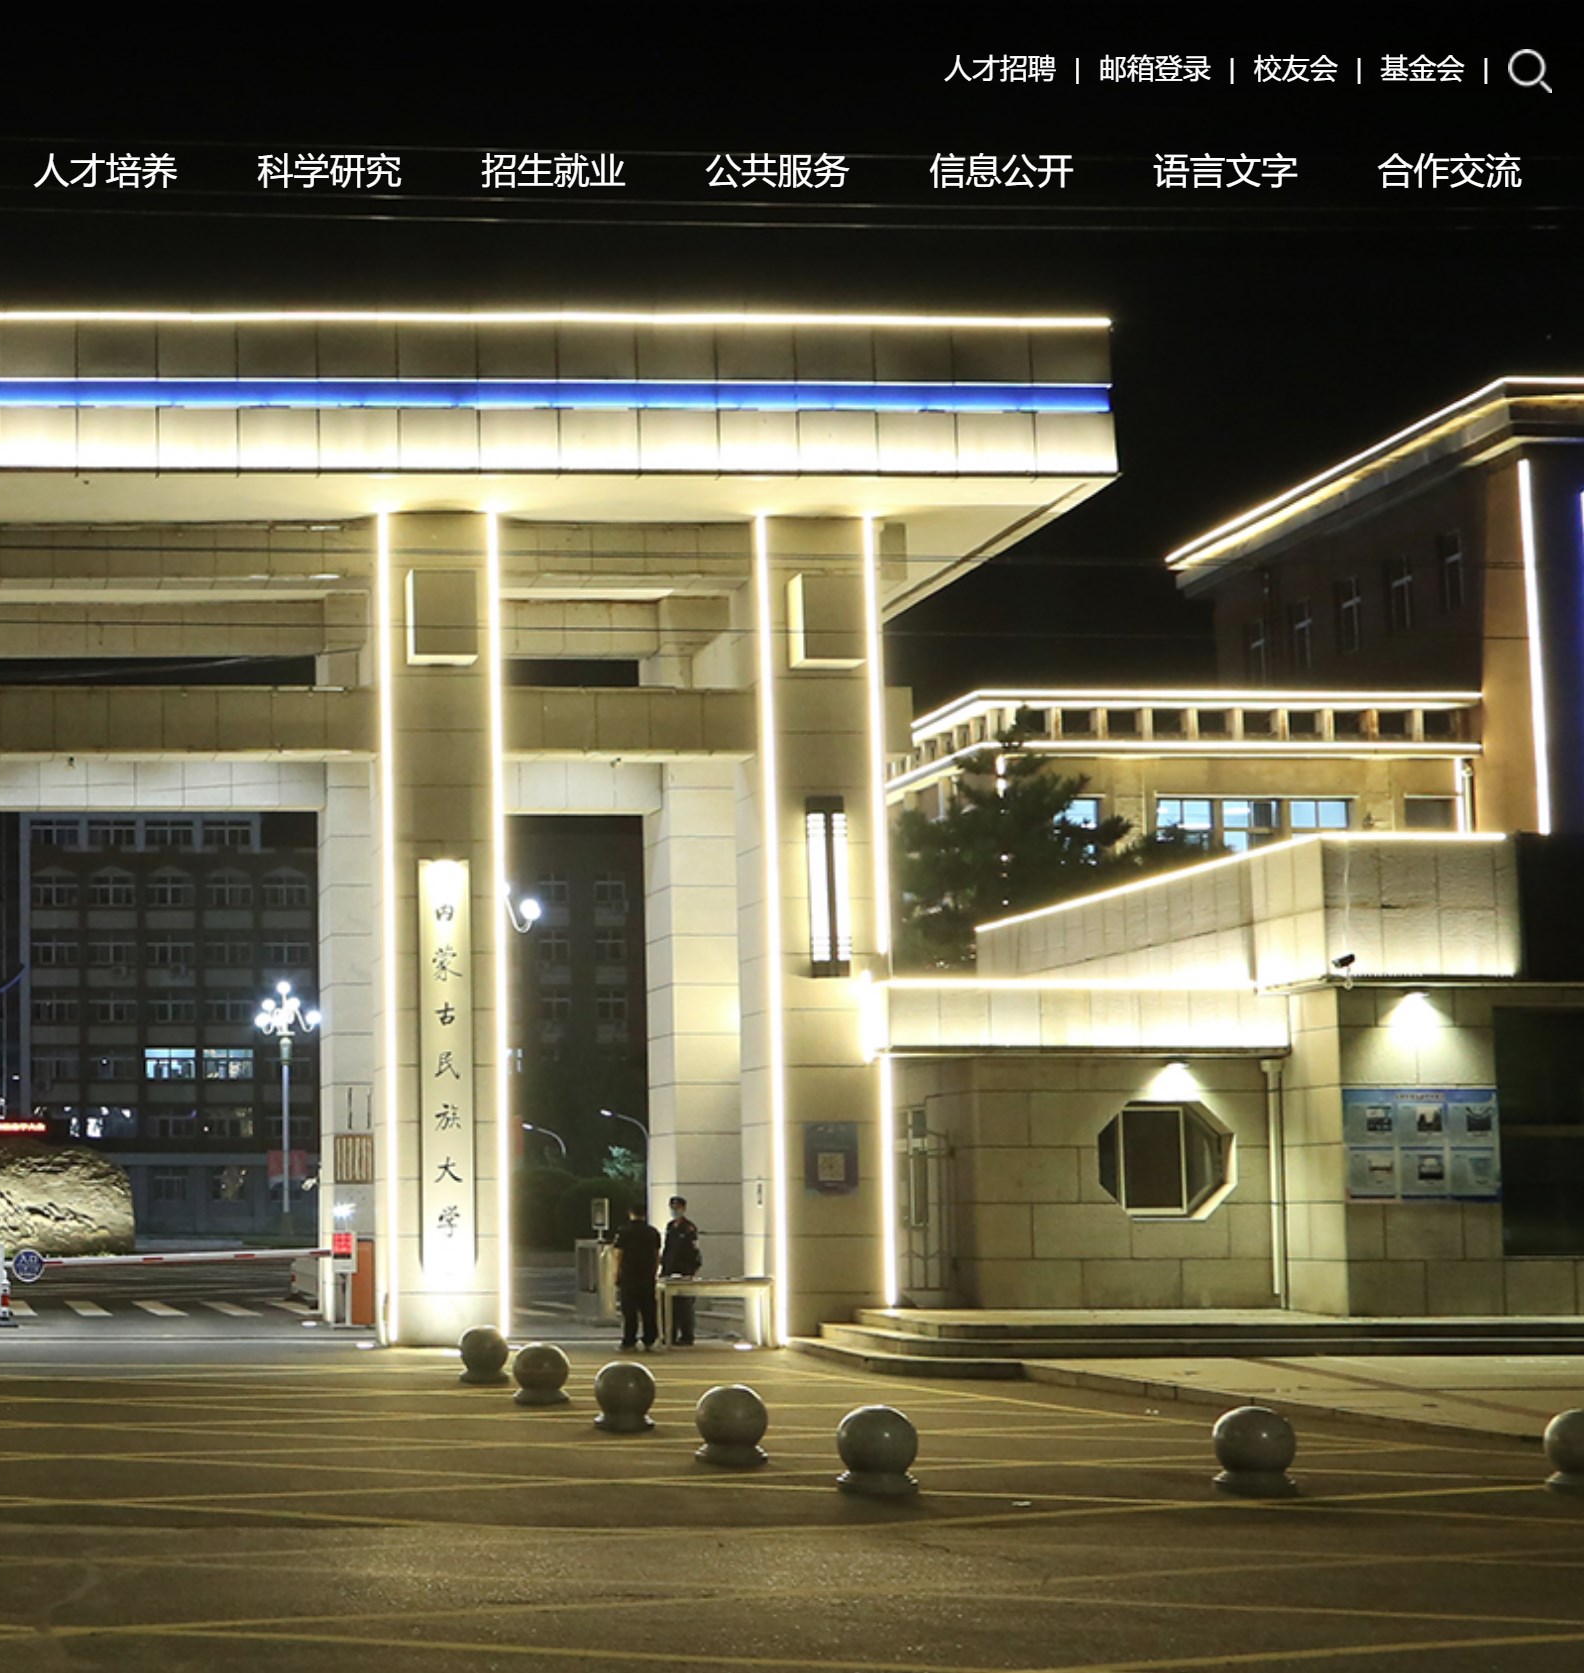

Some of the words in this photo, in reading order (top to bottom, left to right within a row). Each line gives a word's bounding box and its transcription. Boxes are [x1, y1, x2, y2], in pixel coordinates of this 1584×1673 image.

[432, 903, 463, 1239] 内蒙古民族大学
